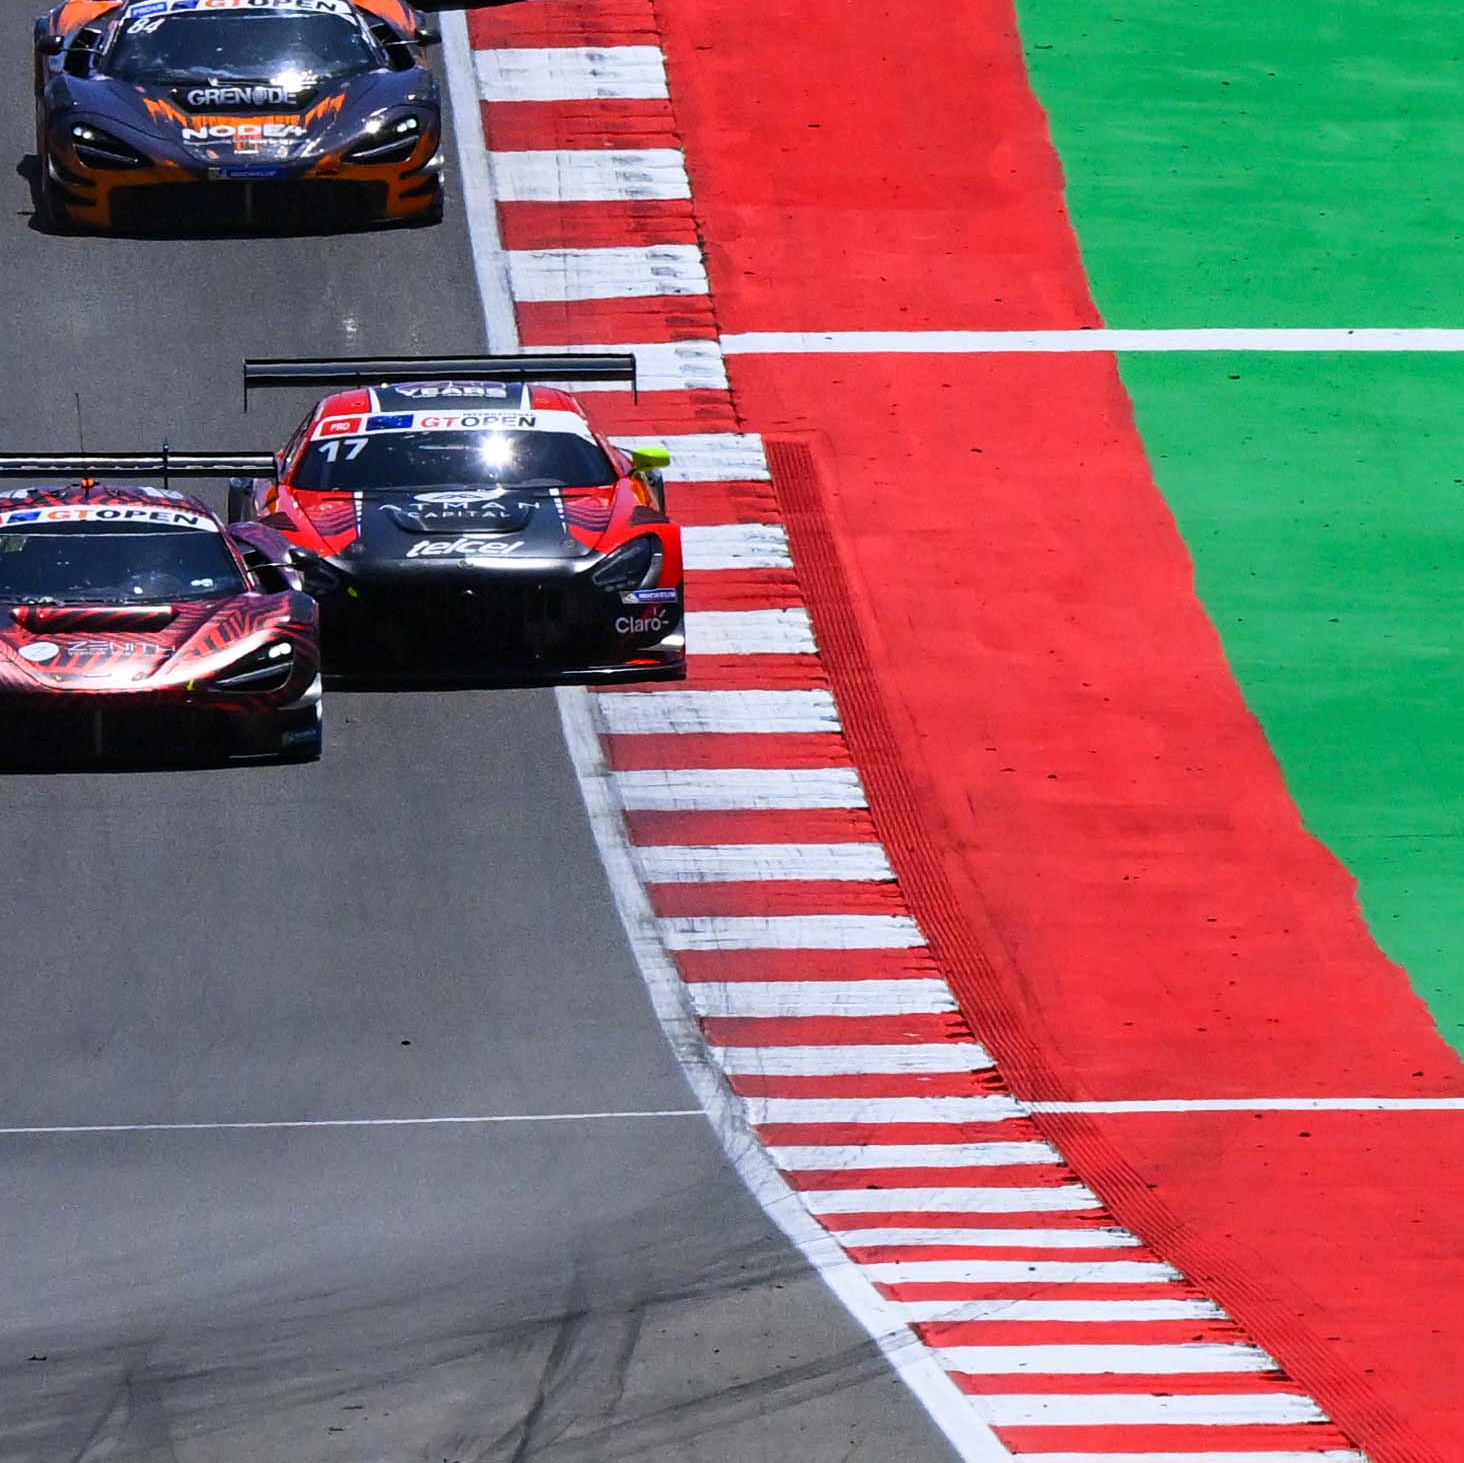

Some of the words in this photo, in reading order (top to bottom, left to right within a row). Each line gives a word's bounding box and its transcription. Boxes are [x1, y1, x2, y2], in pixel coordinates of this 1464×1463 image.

[127, 18, 166, 35] 84
[329, 421, 351, 433] PRO
[420, 417, 537, 428] GTOPEN
[318, 437, 369, 463] 17
[378, 501, 541, 511] ATMAN
[46, 509, 199, 525] GTOPEN
[407, 510, 511, 519] CAPITAL
[405, 538, 526, 558] telcel
[614, 616, 662, 634] Claro
